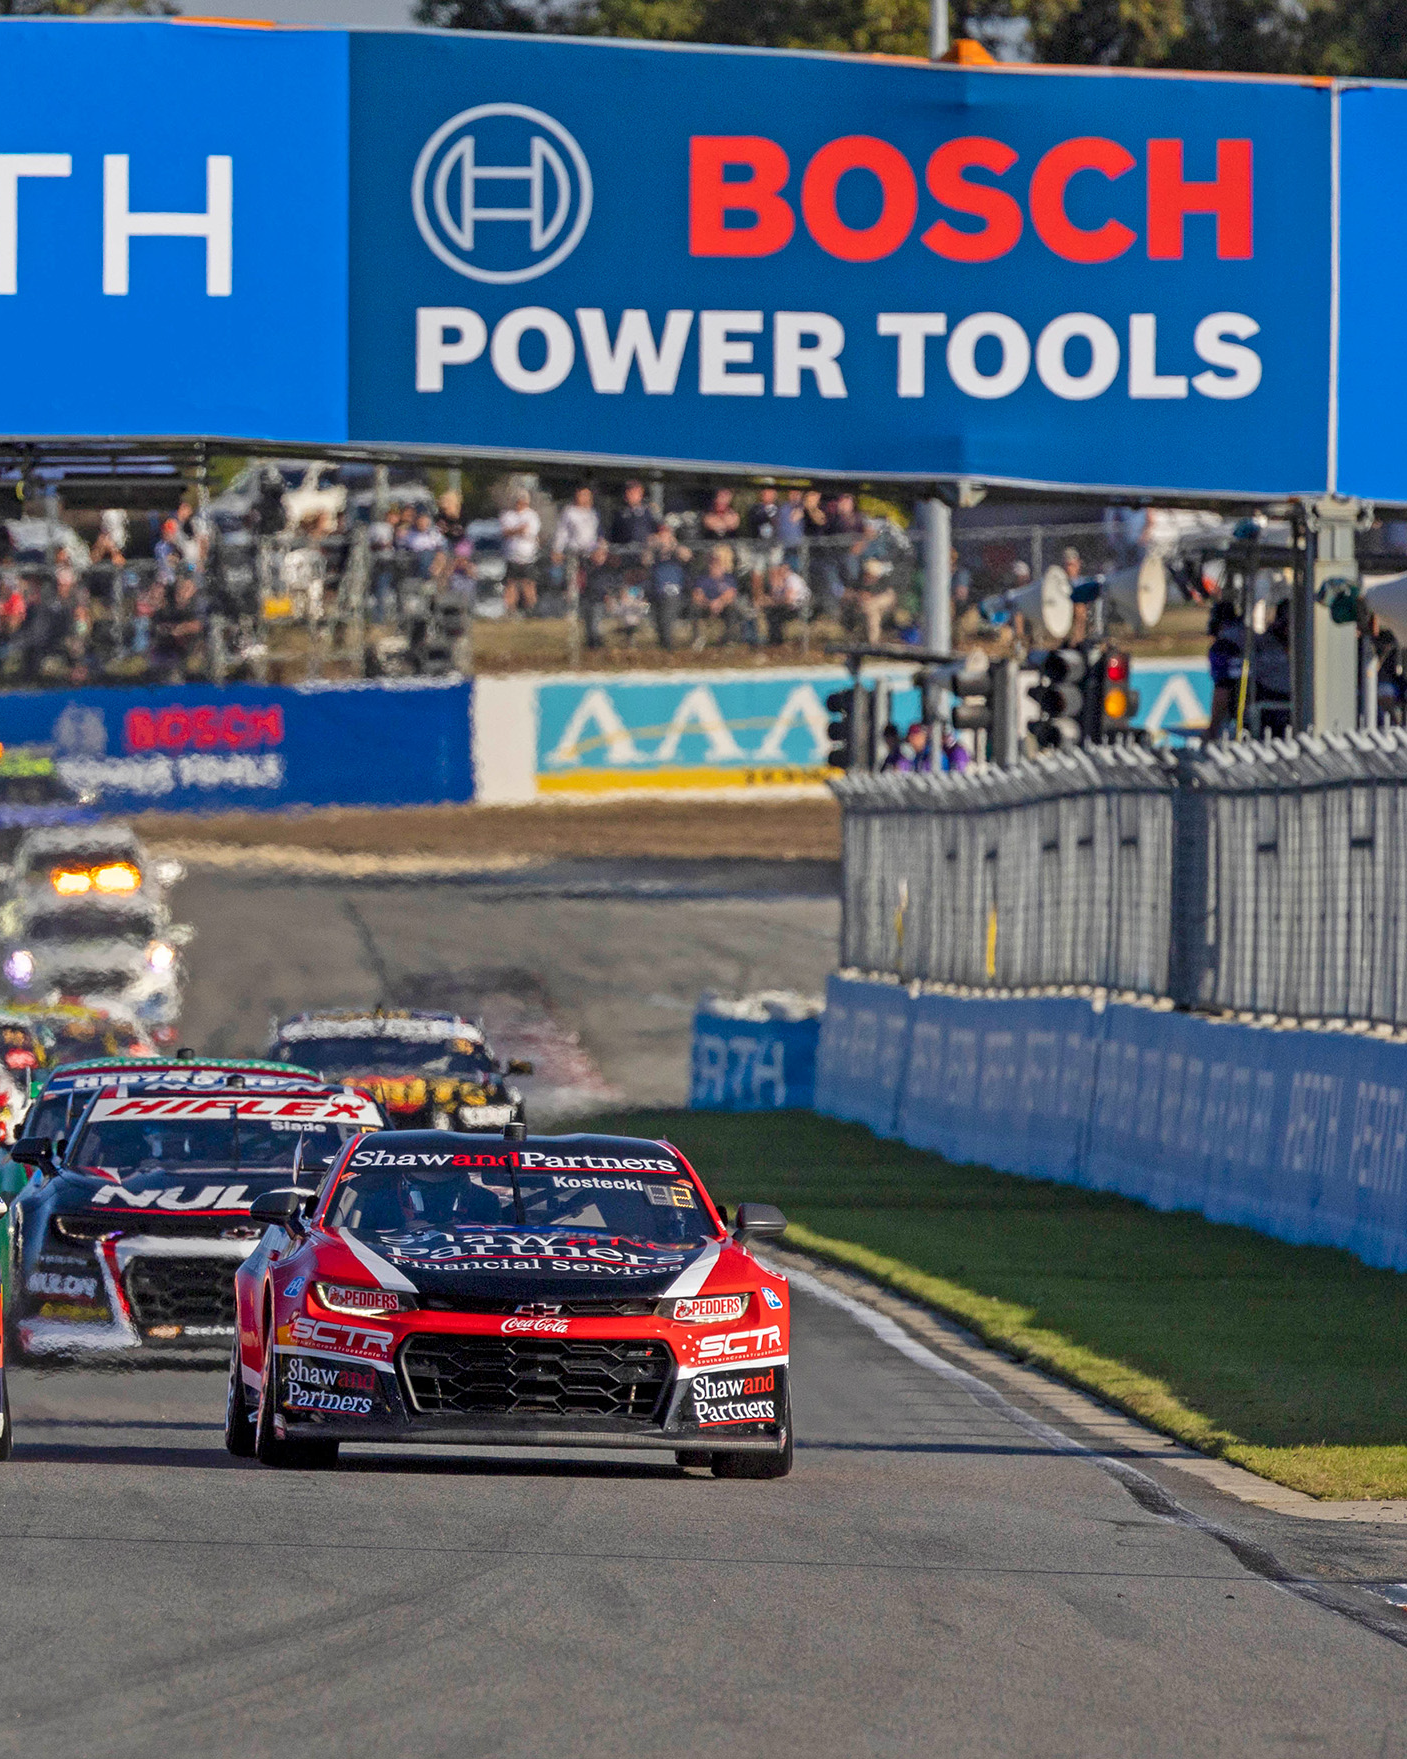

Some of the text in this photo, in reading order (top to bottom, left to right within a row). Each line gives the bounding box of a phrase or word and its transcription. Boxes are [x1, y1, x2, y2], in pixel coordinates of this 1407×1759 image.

[687, 134, 1254, 264] BOSCH
[415, 305, 1264, 401] POWER TOOLS
[105, 1099, 366, 1119] HIFLEX
[270, 1120, 327, 1133] Slade
[553, 1176, 644, 1191] Kostecki
[91, 1185, 255, 1210] NUL
[386, 1244, 686, 1266] Partners
[391, 1257, 683, 1275] Financial Services
[344, 1290, 398, 1310] PEDDERS
[693, 1298, 740, 1315] PEDDERS
[292, 1317, 394, 1352] SCTR
[698, 1325, 782, 1358] SCTR
[288, 1381, 373, 1414] Partners
[694, 1401, 775, 1424] Partners
